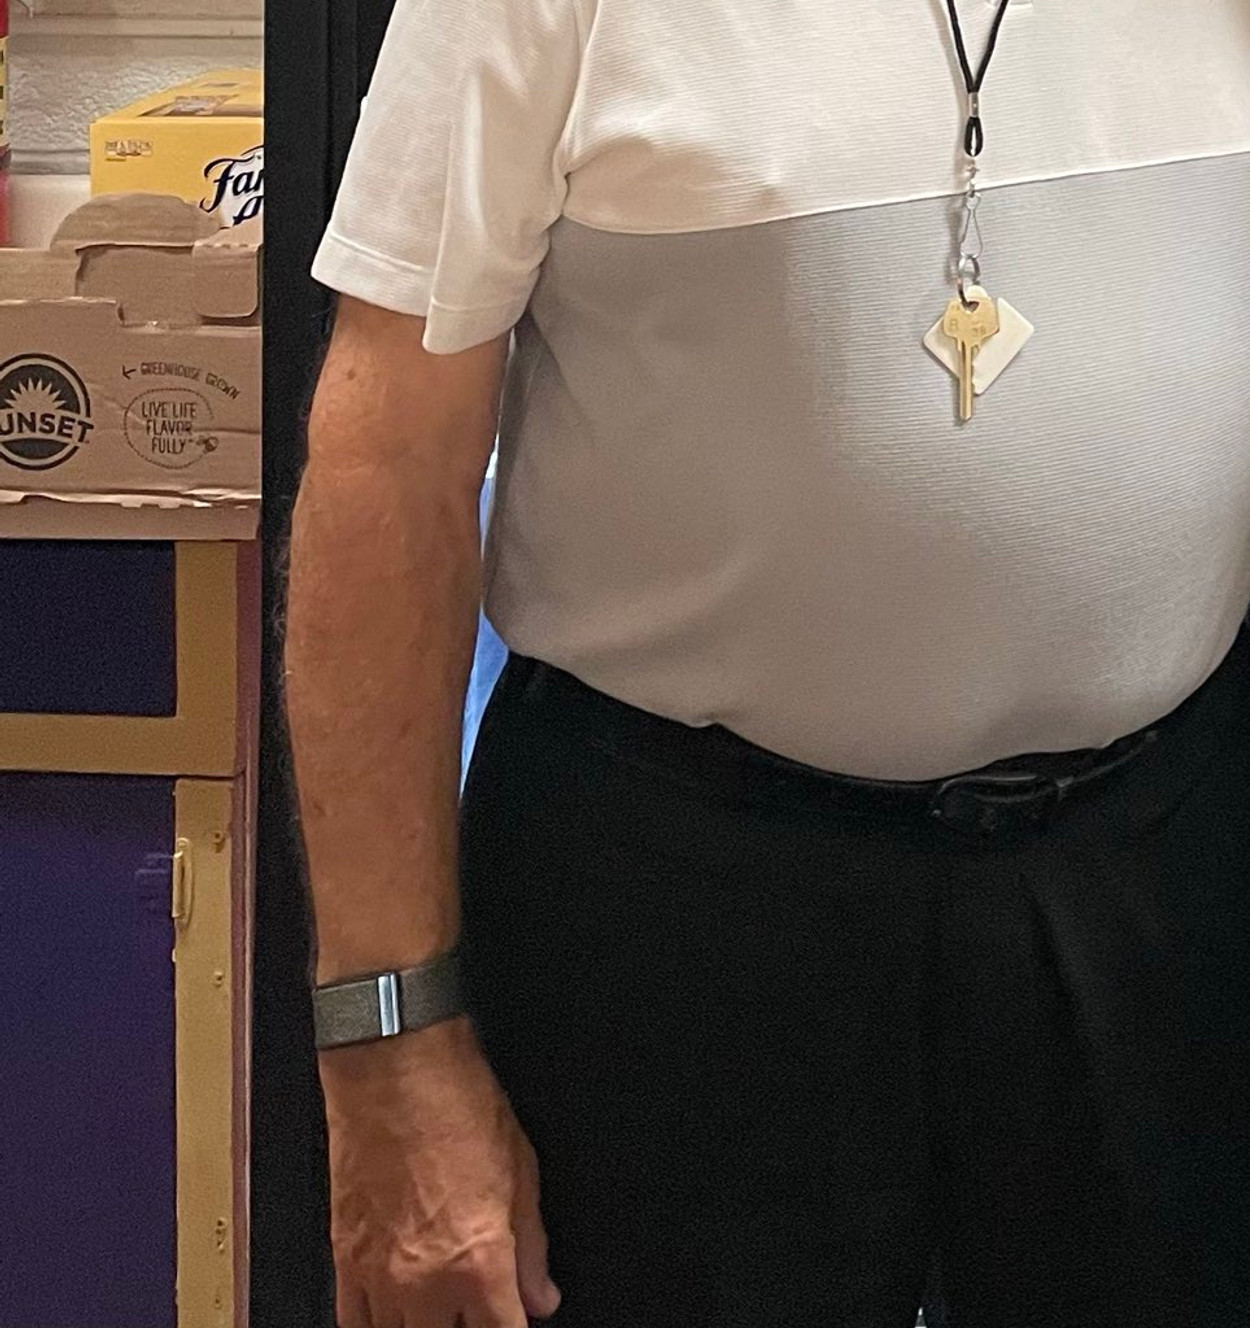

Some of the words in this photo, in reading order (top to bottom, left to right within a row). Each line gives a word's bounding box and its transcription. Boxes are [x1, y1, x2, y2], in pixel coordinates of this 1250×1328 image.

[142, 401, 168, 418] LIVE
[172, 402, 198, 419] LIFE
[0, 411, 95, 443] UNSET
[146, 419, 193, 436] FLAVOR
[152, 436, 186, 454] FULLY
